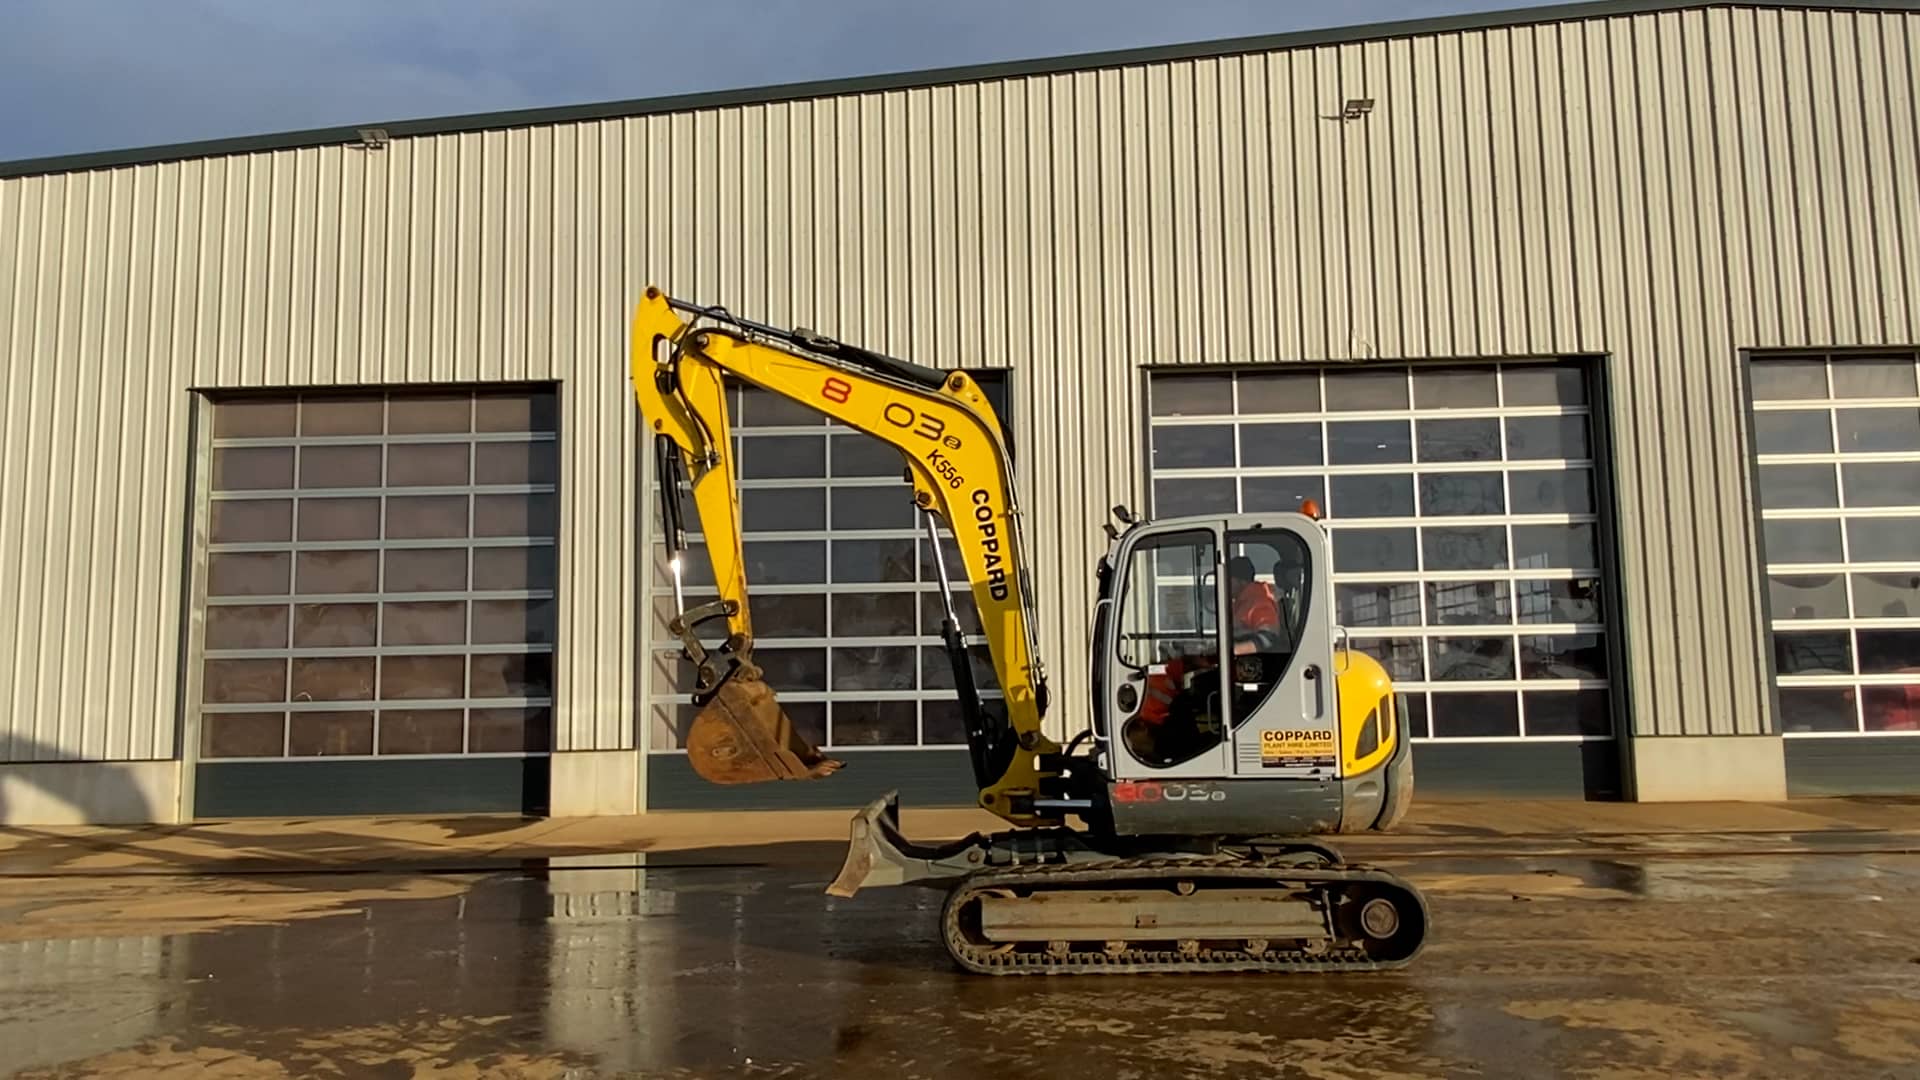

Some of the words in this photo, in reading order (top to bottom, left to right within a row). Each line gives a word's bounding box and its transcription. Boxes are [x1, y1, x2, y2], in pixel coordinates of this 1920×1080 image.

[821, 377, 852, 404] 8
[926, 449, 965, 489] K556
[971, 489, 1009, 601] COPPARD
[1263, 730, 1332, 741] COPPARD
